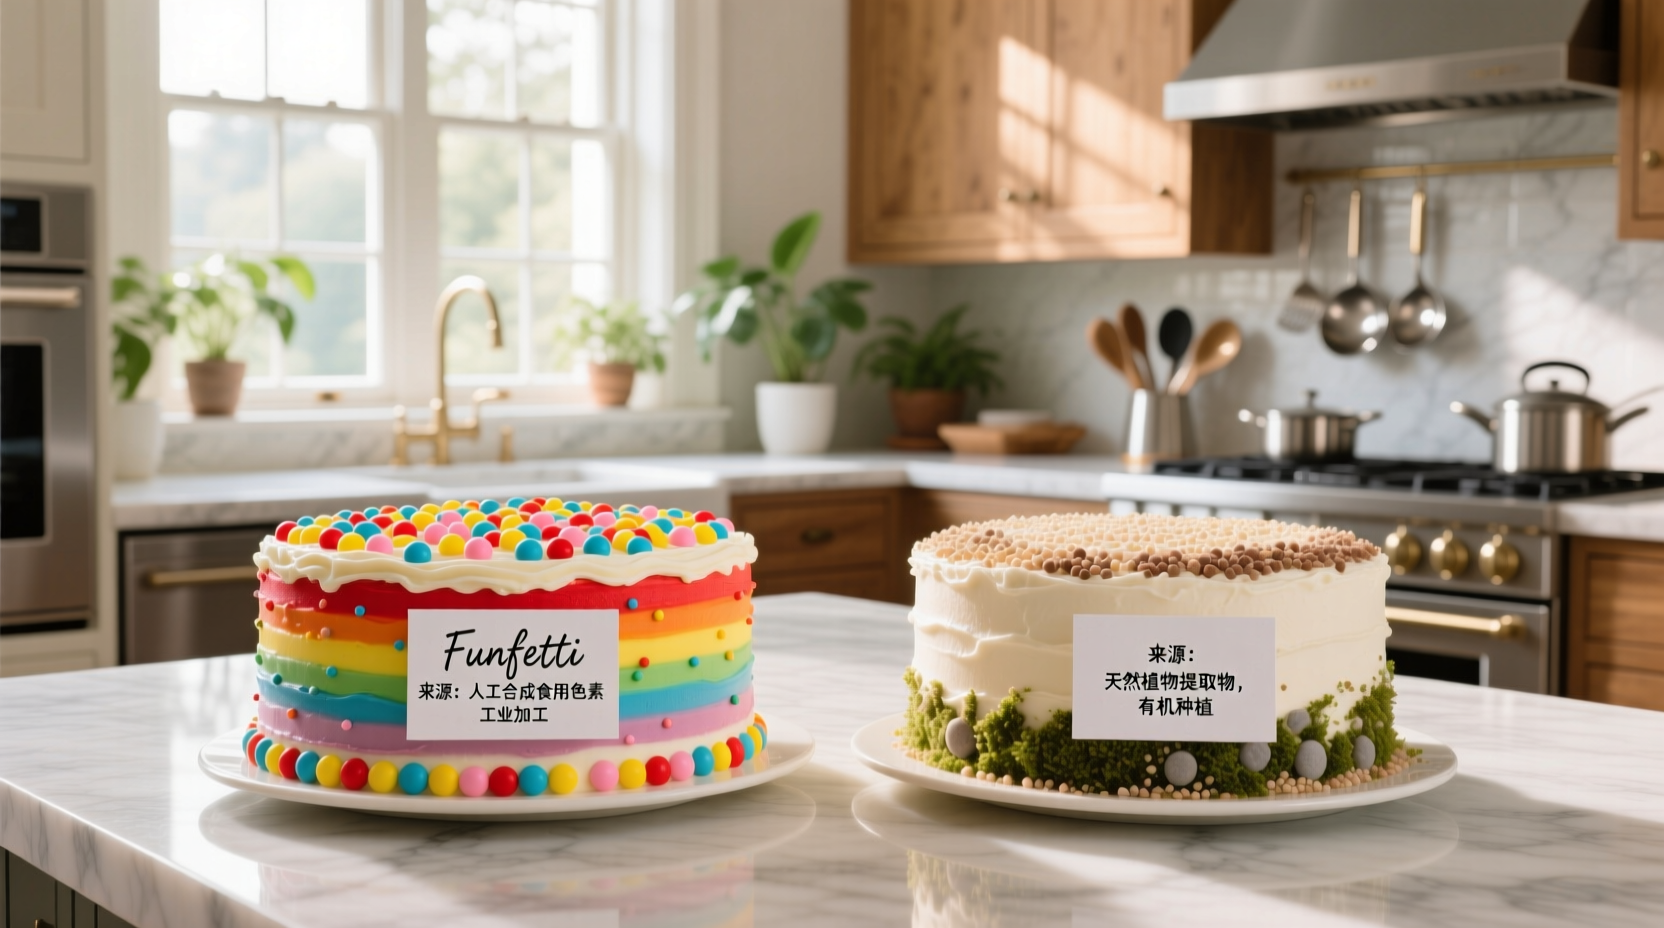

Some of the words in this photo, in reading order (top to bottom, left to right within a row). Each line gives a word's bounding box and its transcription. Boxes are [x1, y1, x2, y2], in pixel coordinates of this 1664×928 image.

[444, 628, 585, 680] Funfetti
[1147, 642, 1194, 665] 来源：
[1104, 671, 1243, 693] 天然植物提取物，
[480, 705, 549, 723] 工业加工
[1138, 696, 1214, 717] 有机种植
